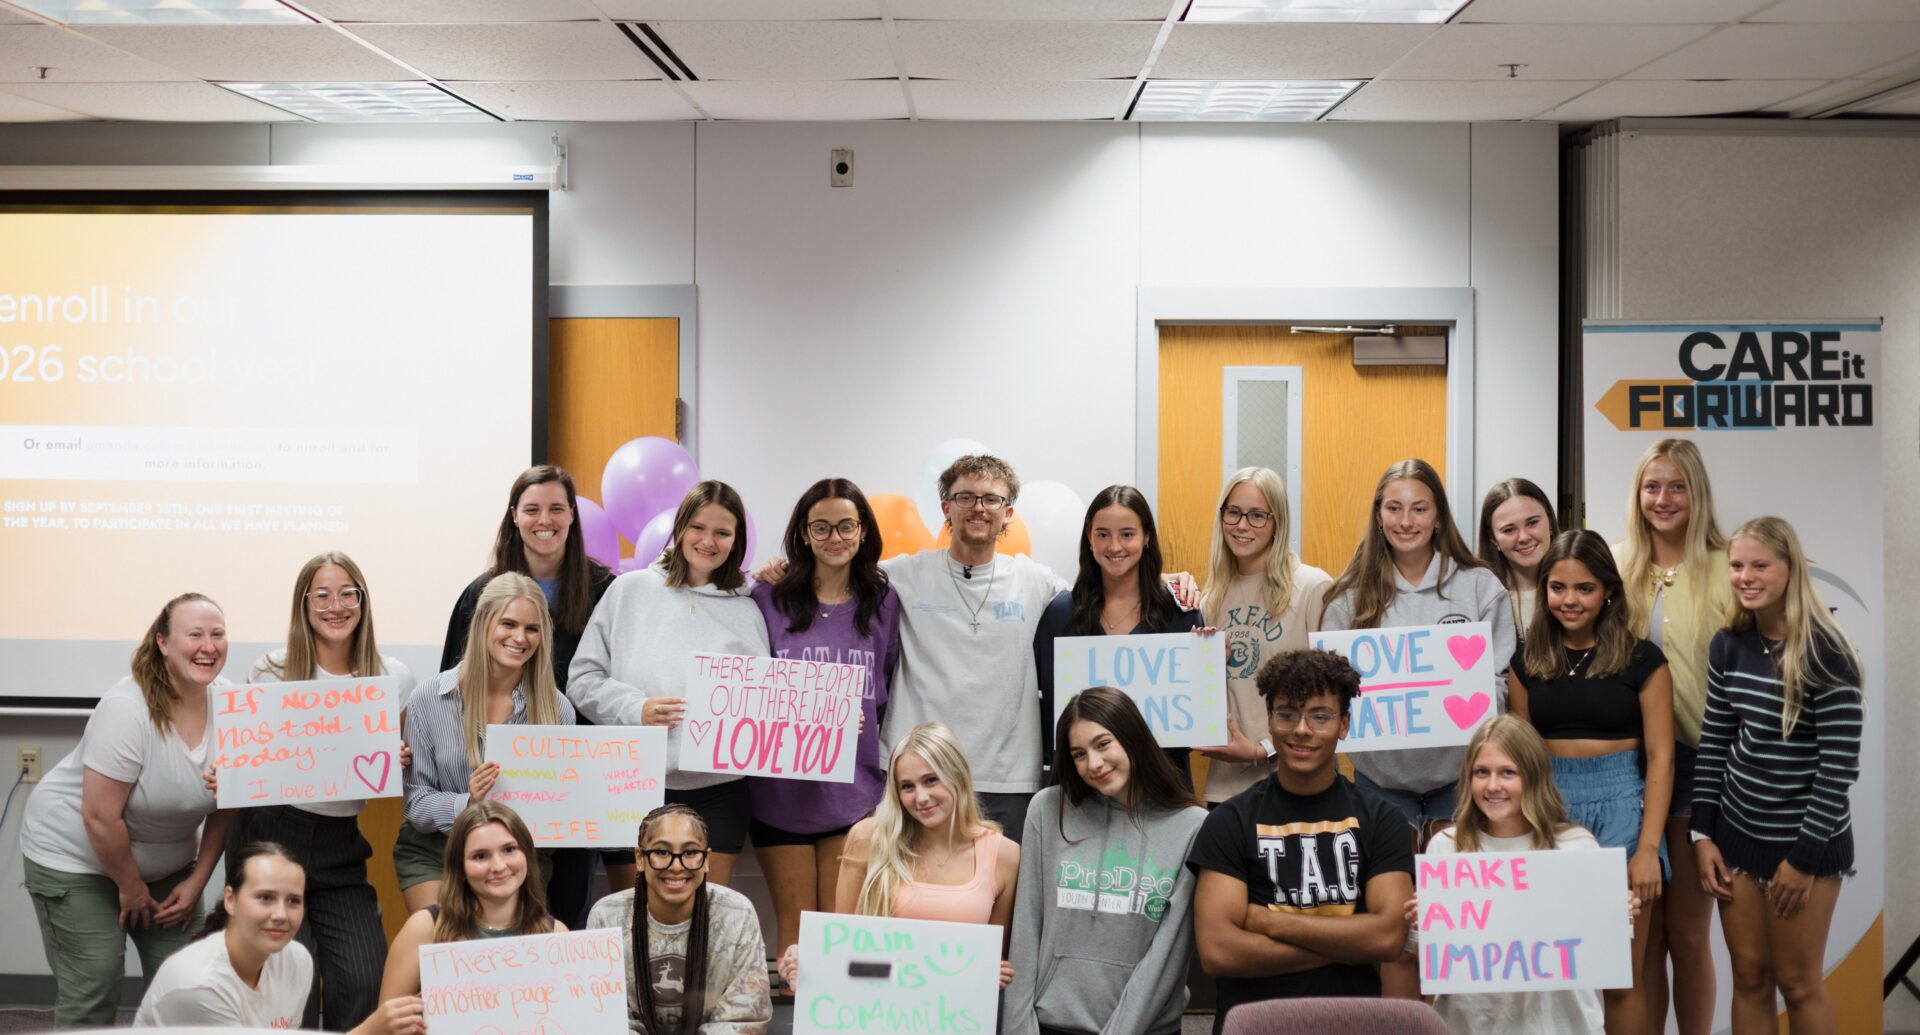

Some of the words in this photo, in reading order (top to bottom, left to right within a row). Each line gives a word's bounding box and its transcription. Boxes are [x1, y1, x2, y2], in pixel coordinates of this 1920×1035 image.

[0, 287, 108, 324] enroll
[123, 287, 160, 324] in
[78, 345, 218, 384] school
[1629, 384, 1873, 428] FORWARD
[23, 438, 41, 451] Or
[46, 437, 82, 451] email
[340, 441, 366, 455] and
[370, 440, 391, 456] for
[144, 459, 179, 470] more
[185, 457, 267, 471] information.
[3, 500, 37, 513] SIGN
[39, 500, 57, 513] UP
[60, 500, 77, 513] BY
[79, 501, 153, 514] SEPTEMBER
[195, 503, 225, 515] OUR
[227, 503, 259, 516] FIRST
[262, 503, 322, 516] MEETING
[327, 503, 347, 516] OF
[3, 514, 30, 528] THE
[32, 514, 70, 531] YEAR,
[72, 515, 90, 529] TO
[93, 516, 173, 530] PARTICIPATE
[175, 517, 191, 530] IN
[192, 518, 217, 531] ALL
[220, 518, 241, 532] WE
[244, 518, 280, 532] HAVE
[283, 519, 349, 533] PLANNED!
[694, 655, 757, 682] THERE
[762, 660, 801, 688] ARE
[804, 661, 864, 698] PEOPLE
[1088, 646, 1191, 687] LOVE
[218, 687, 265, 715] If
[710, 685, 757, 719] OUT
[757, 686, 809, 722] THERE
[812, 692, 851, 728] WHO
[276, 715, 352, 738] told
[512, 735, 641, 762] CULTIVATE
[712, 717, 789, 774] LOVE
[793, 723, 844, 775] YOU
[248, 778, 269, 800] I
[280, 783, 319, 800] love
[560, 767, 580, 785] A
[607, 778, 657, 795] HEARTED
[532, 820, 602, 842] LIFE
[1420, 857, 1530, 891] MAKE
[1091, 897, 1122, 909] CNTER
[1422, 899, 1492, 932] AN
[823, 921, 915, 955] Pain
[422, 940, 541, 977] There's
[896, 958, 928, 989] is
[1425, 938, 1582, 982] IMPACT
[424, 984, 502, 1018] another
[510, 981, 560, 1019] page
[565, 973, 585, 999] in
